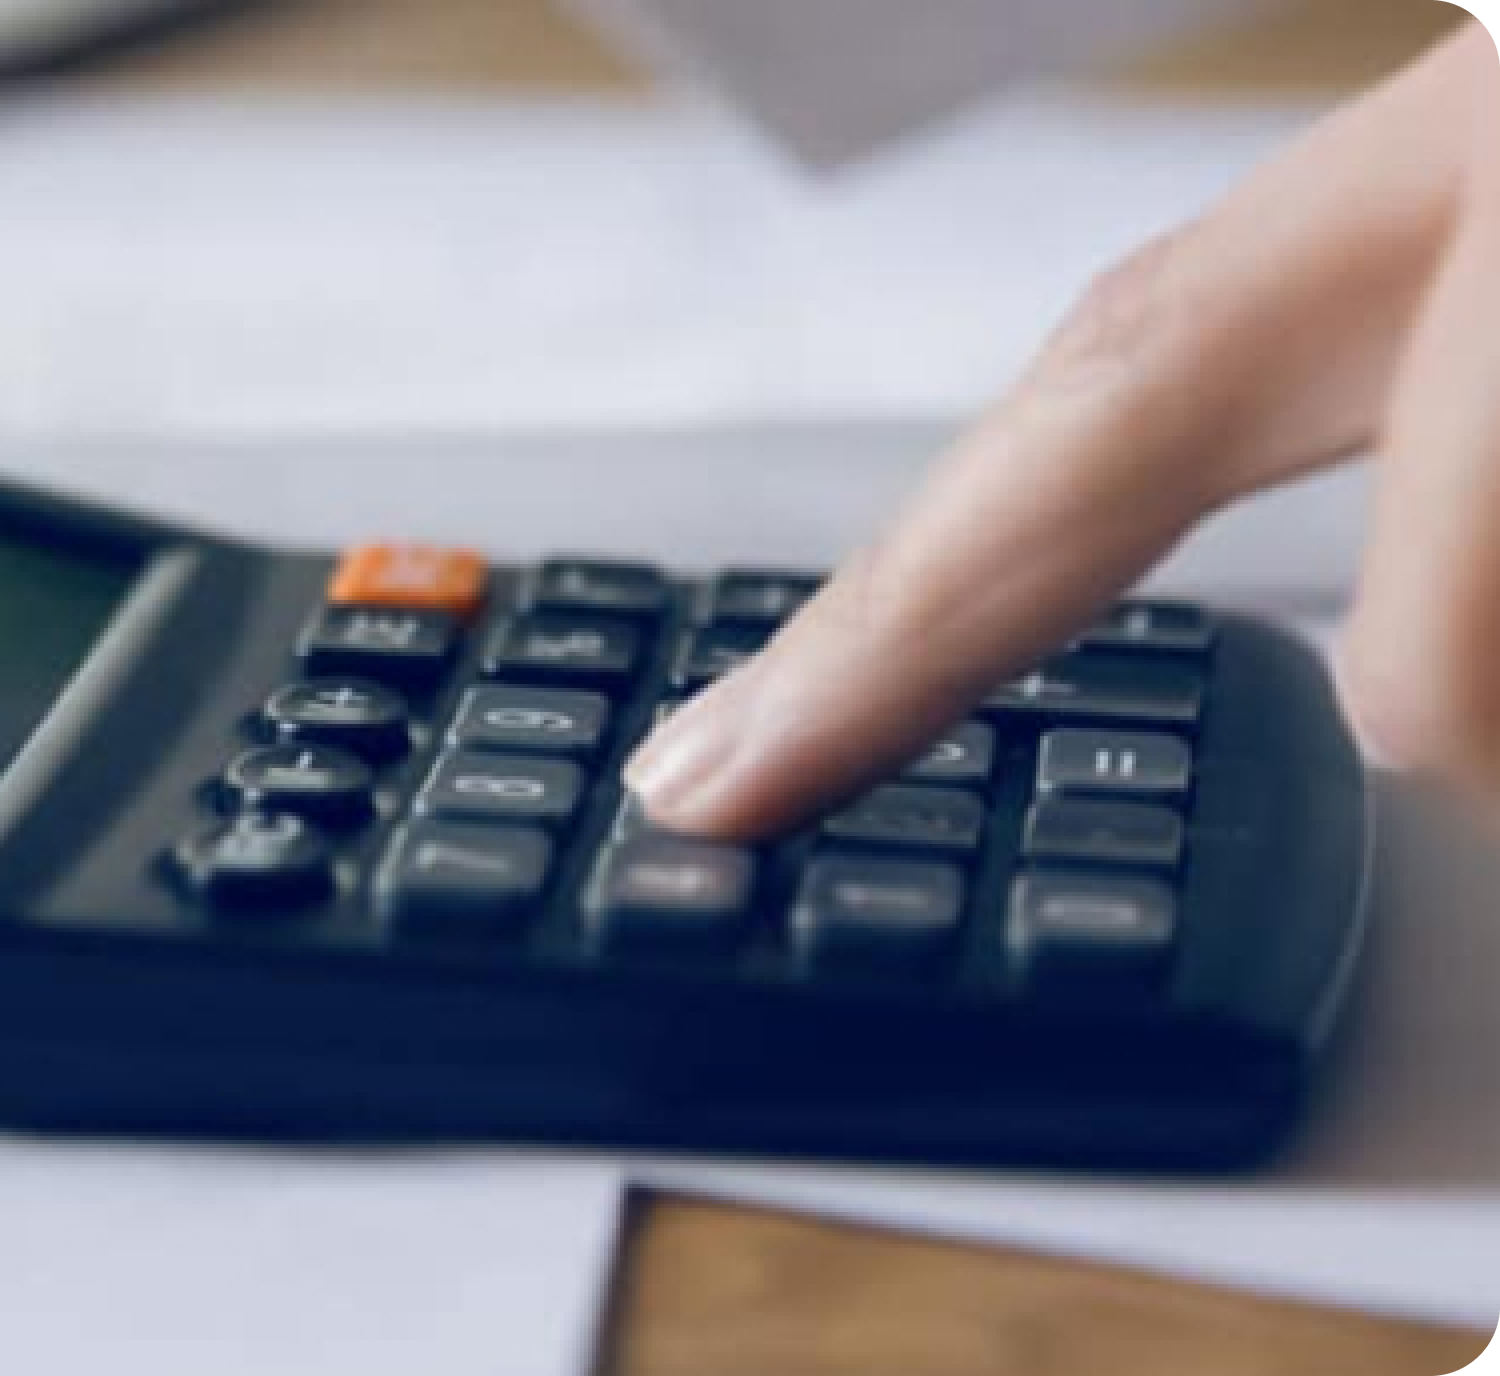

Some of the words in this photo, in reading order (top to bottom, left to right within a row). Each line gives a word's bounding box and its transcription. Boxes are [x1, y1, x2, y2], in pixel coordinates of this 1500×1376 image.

[483, 708, 573, 733] 9
[1095, 747, 1138, 779] =
[453, 773, 545, 797] 8
